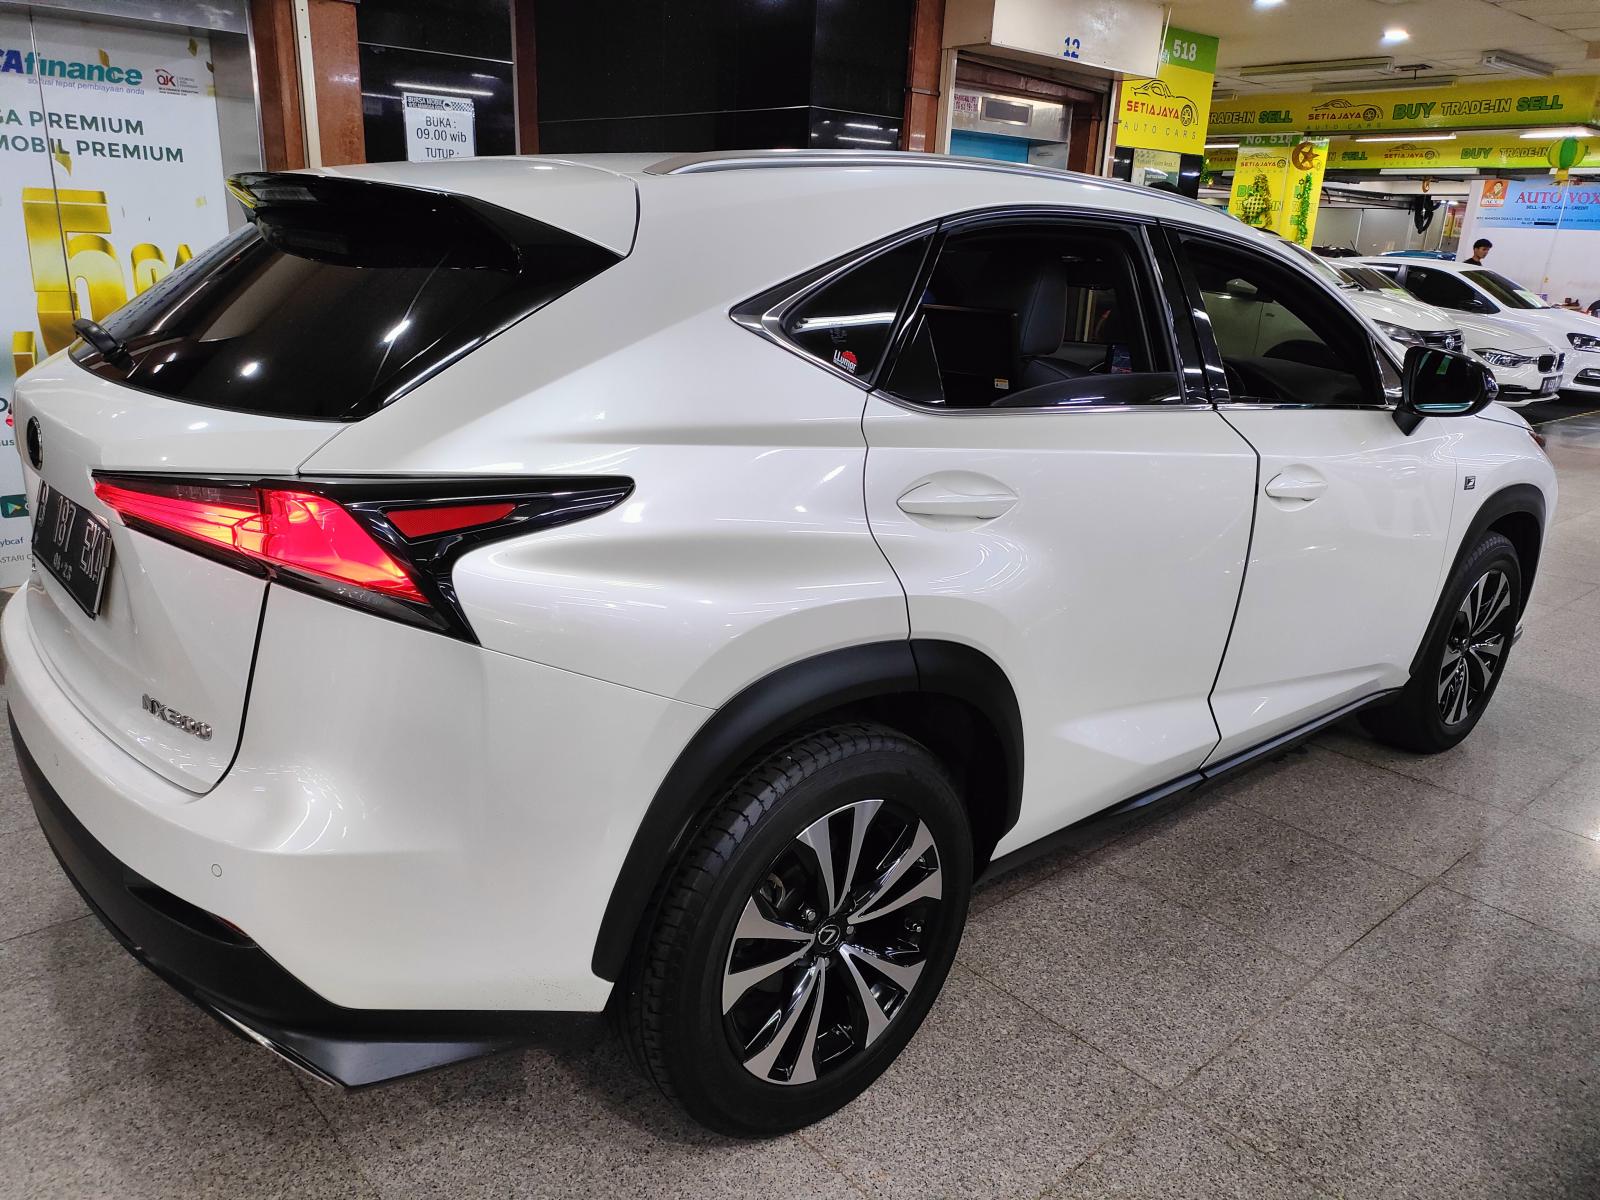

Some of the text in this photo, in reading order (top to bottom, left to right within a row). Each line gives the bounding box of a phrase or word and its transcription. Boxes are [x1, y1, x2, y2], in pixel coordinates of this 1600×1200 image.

[1064, 36, 1080, 58] 12
[1173, 39, 1197, 62] 518
[77, 83, 124, 93] pembiayaan
[126, 88, 145, 96] anda
[1127, 100, 1179, 120] SETIAJAYA
[1392, 94, 1563, 120] BUY TRADE-IN SELL
[0, 109, 144, 136] A PREMIUM
[425, 116, 451, 128] BUKA
[1258, 110, 1293, 124] SELL
[1308, 112, 1361, 121] SETIAJAYA
[416, 127, 467, 143] 09.00 wib
[1124, 121, 1196, 140] AUTO CARS
[76, 139, 184, 163] PREMIUM
[425, 147, 454, 159] TUTUP
[1461, 147, 1493, 160] BUY
[1515, 191, 1563, 205] AUTO
[53, 495, 77, 553] 187
[0, 554, 25, 564] STARI
